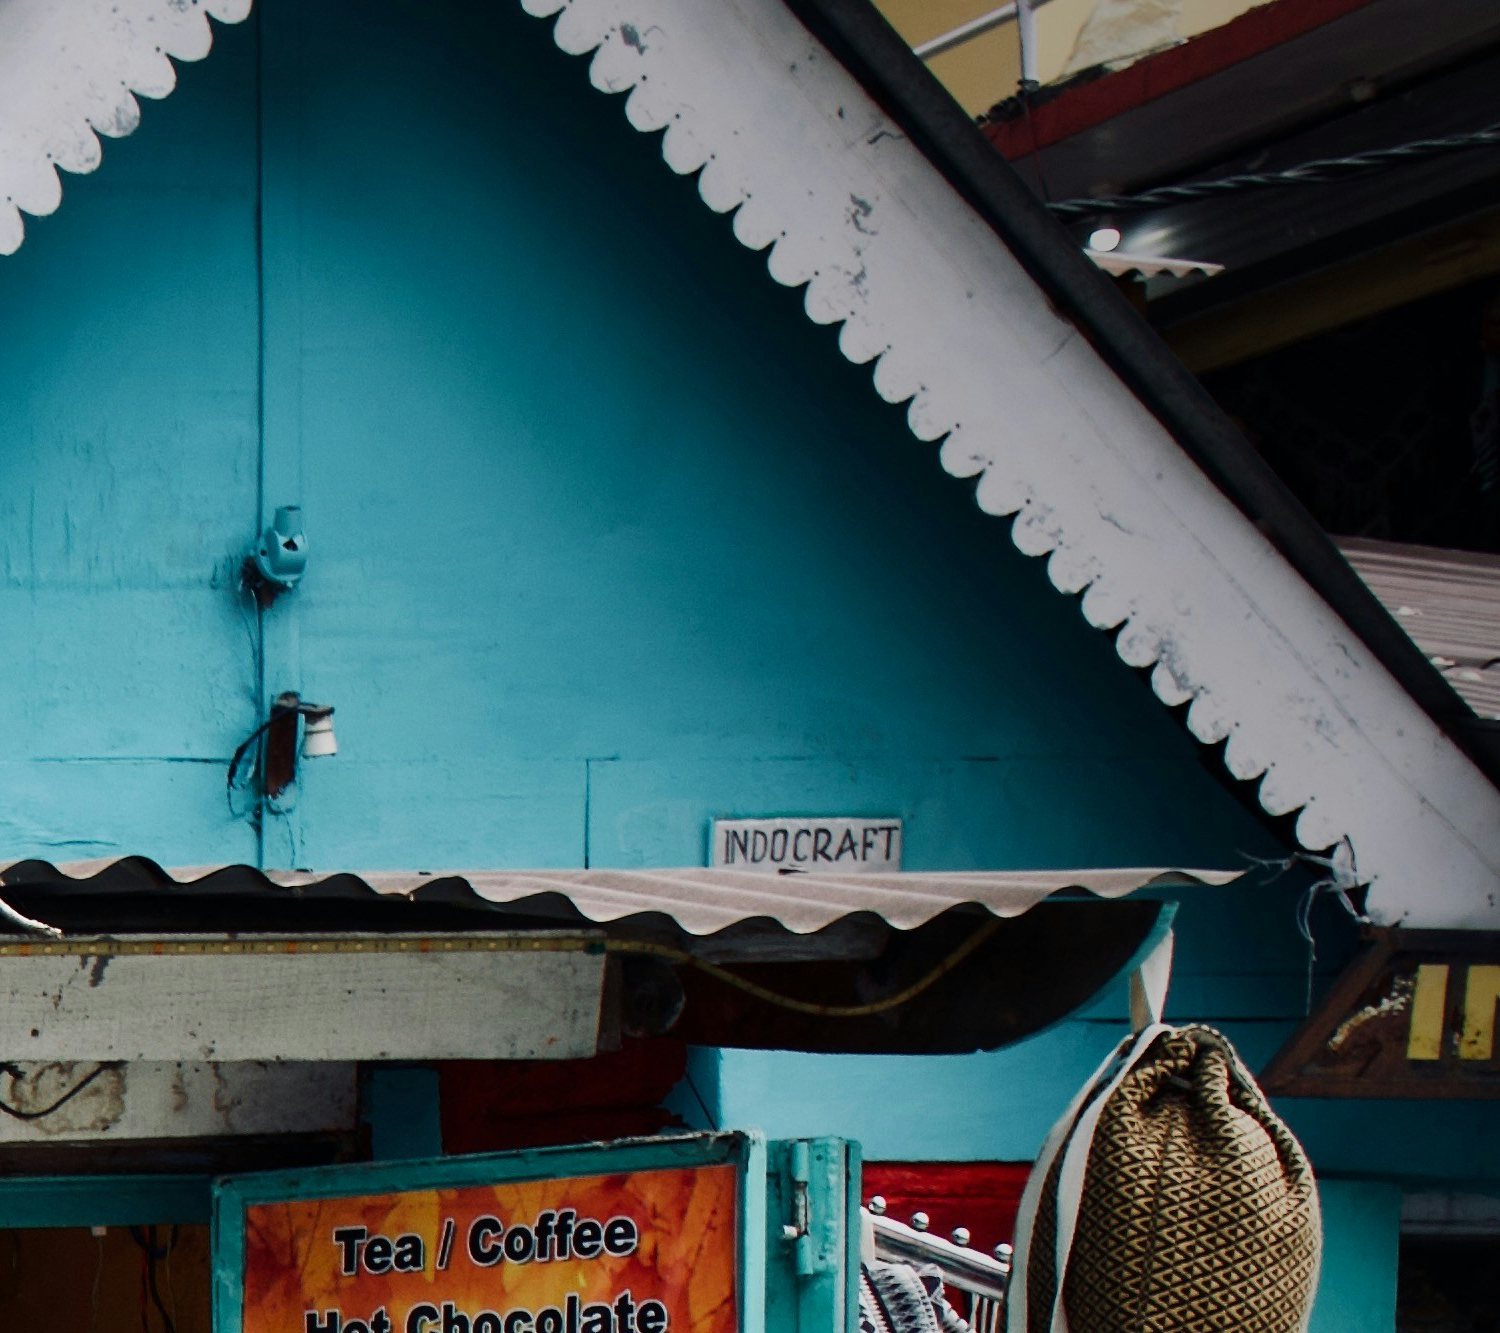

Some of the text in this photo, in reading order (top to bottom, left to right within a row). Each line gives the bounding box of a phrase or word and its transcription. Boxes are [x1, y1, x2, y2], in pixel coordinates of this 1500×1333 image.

[723, 826, 900, 865] INDOCRAFT
[336, 1228, 422, 1275] Tea
[468, 1215, 639, 1268] Coffee
